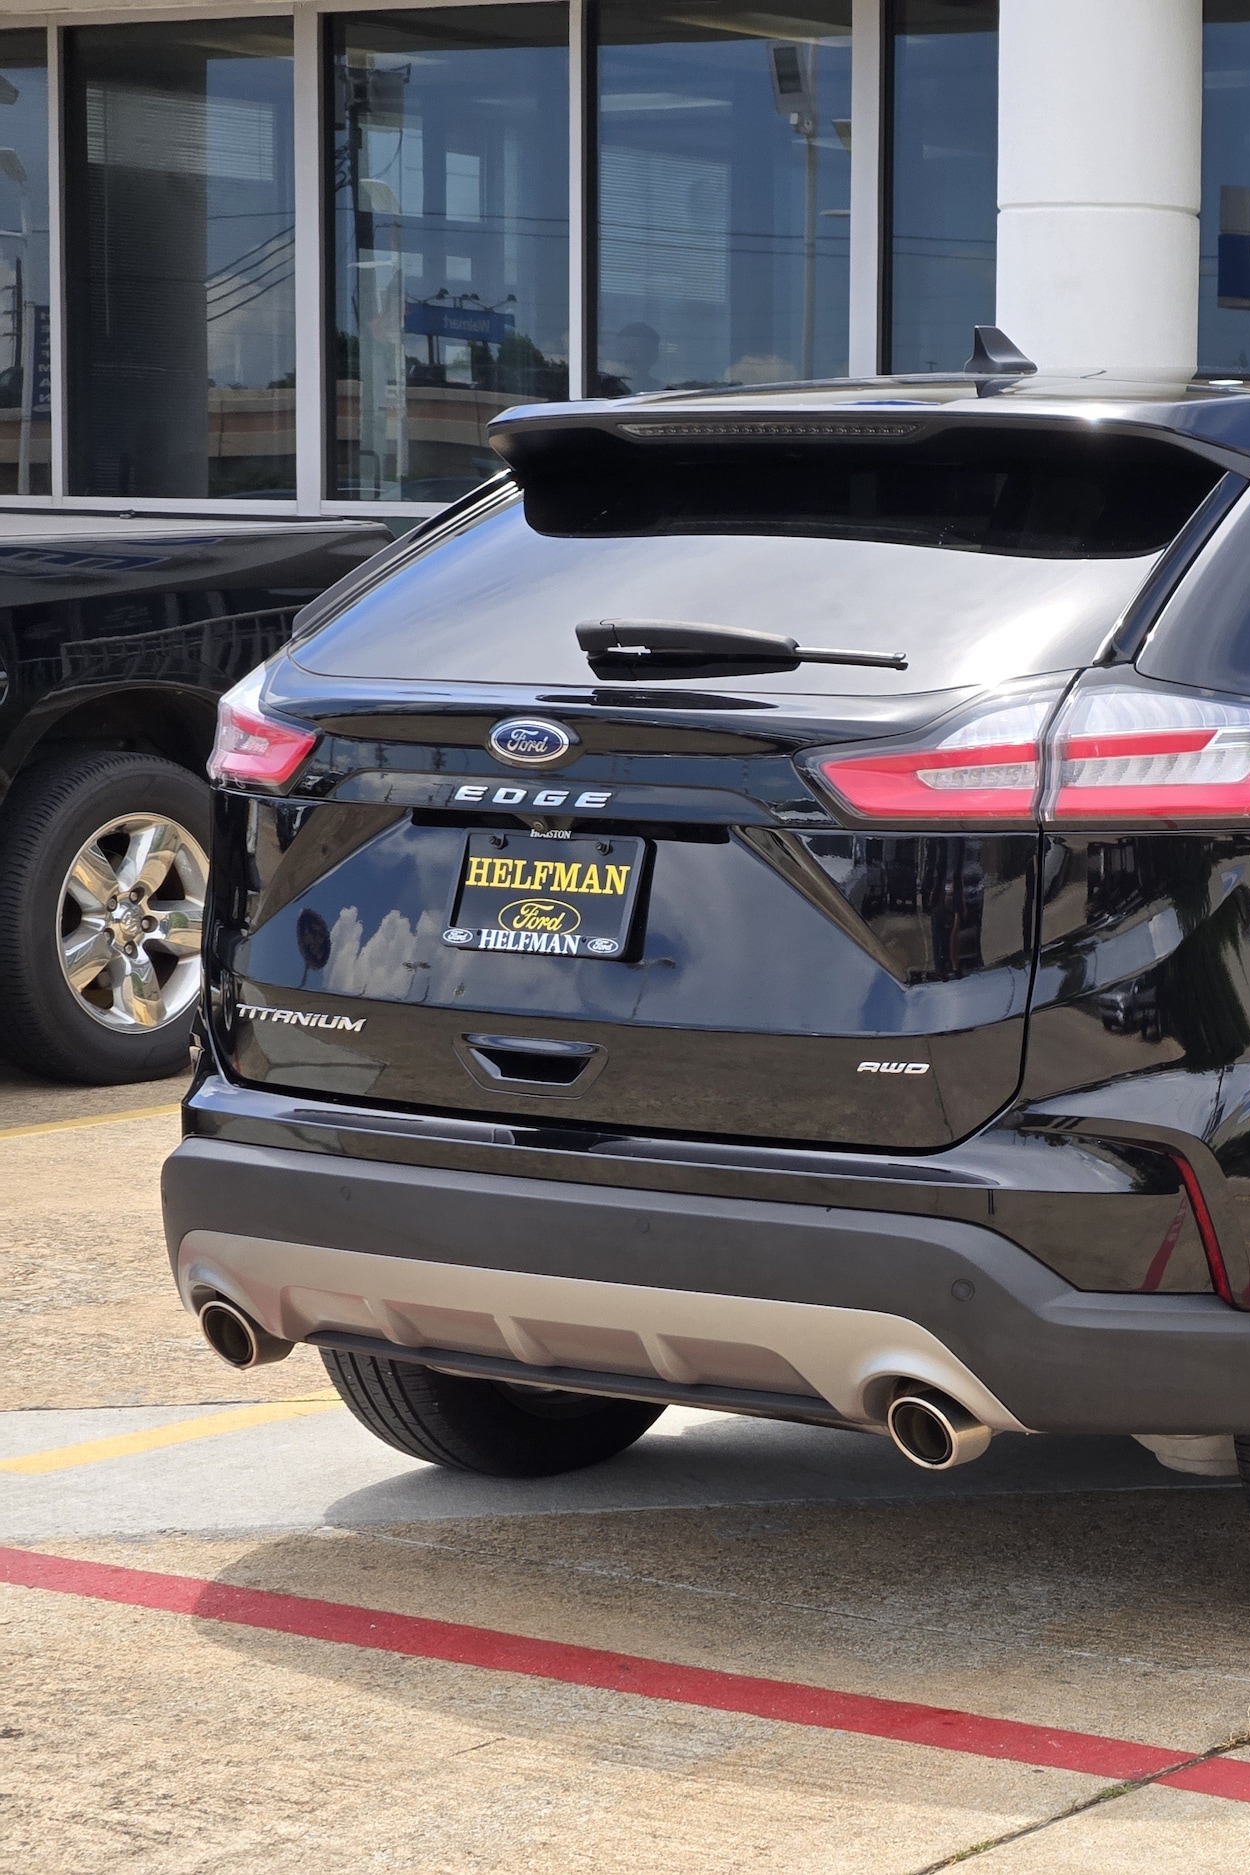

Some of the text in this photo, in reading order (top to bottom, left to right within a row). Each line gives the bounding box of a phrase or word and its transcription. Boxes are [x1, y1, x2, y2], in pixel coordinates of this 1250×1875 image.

[507, 729, 549, 752] Ford
[454, 785, 612, 808] EDGE
[465, 856, 631, 895] HELFMAN
[512, 902, 566, 931] Ford
[478, 929, 581, 955] HELFMAN
[236, 1003, 367, 1032] TITANIUM
[857, 1061, 930, 1074] AWD
